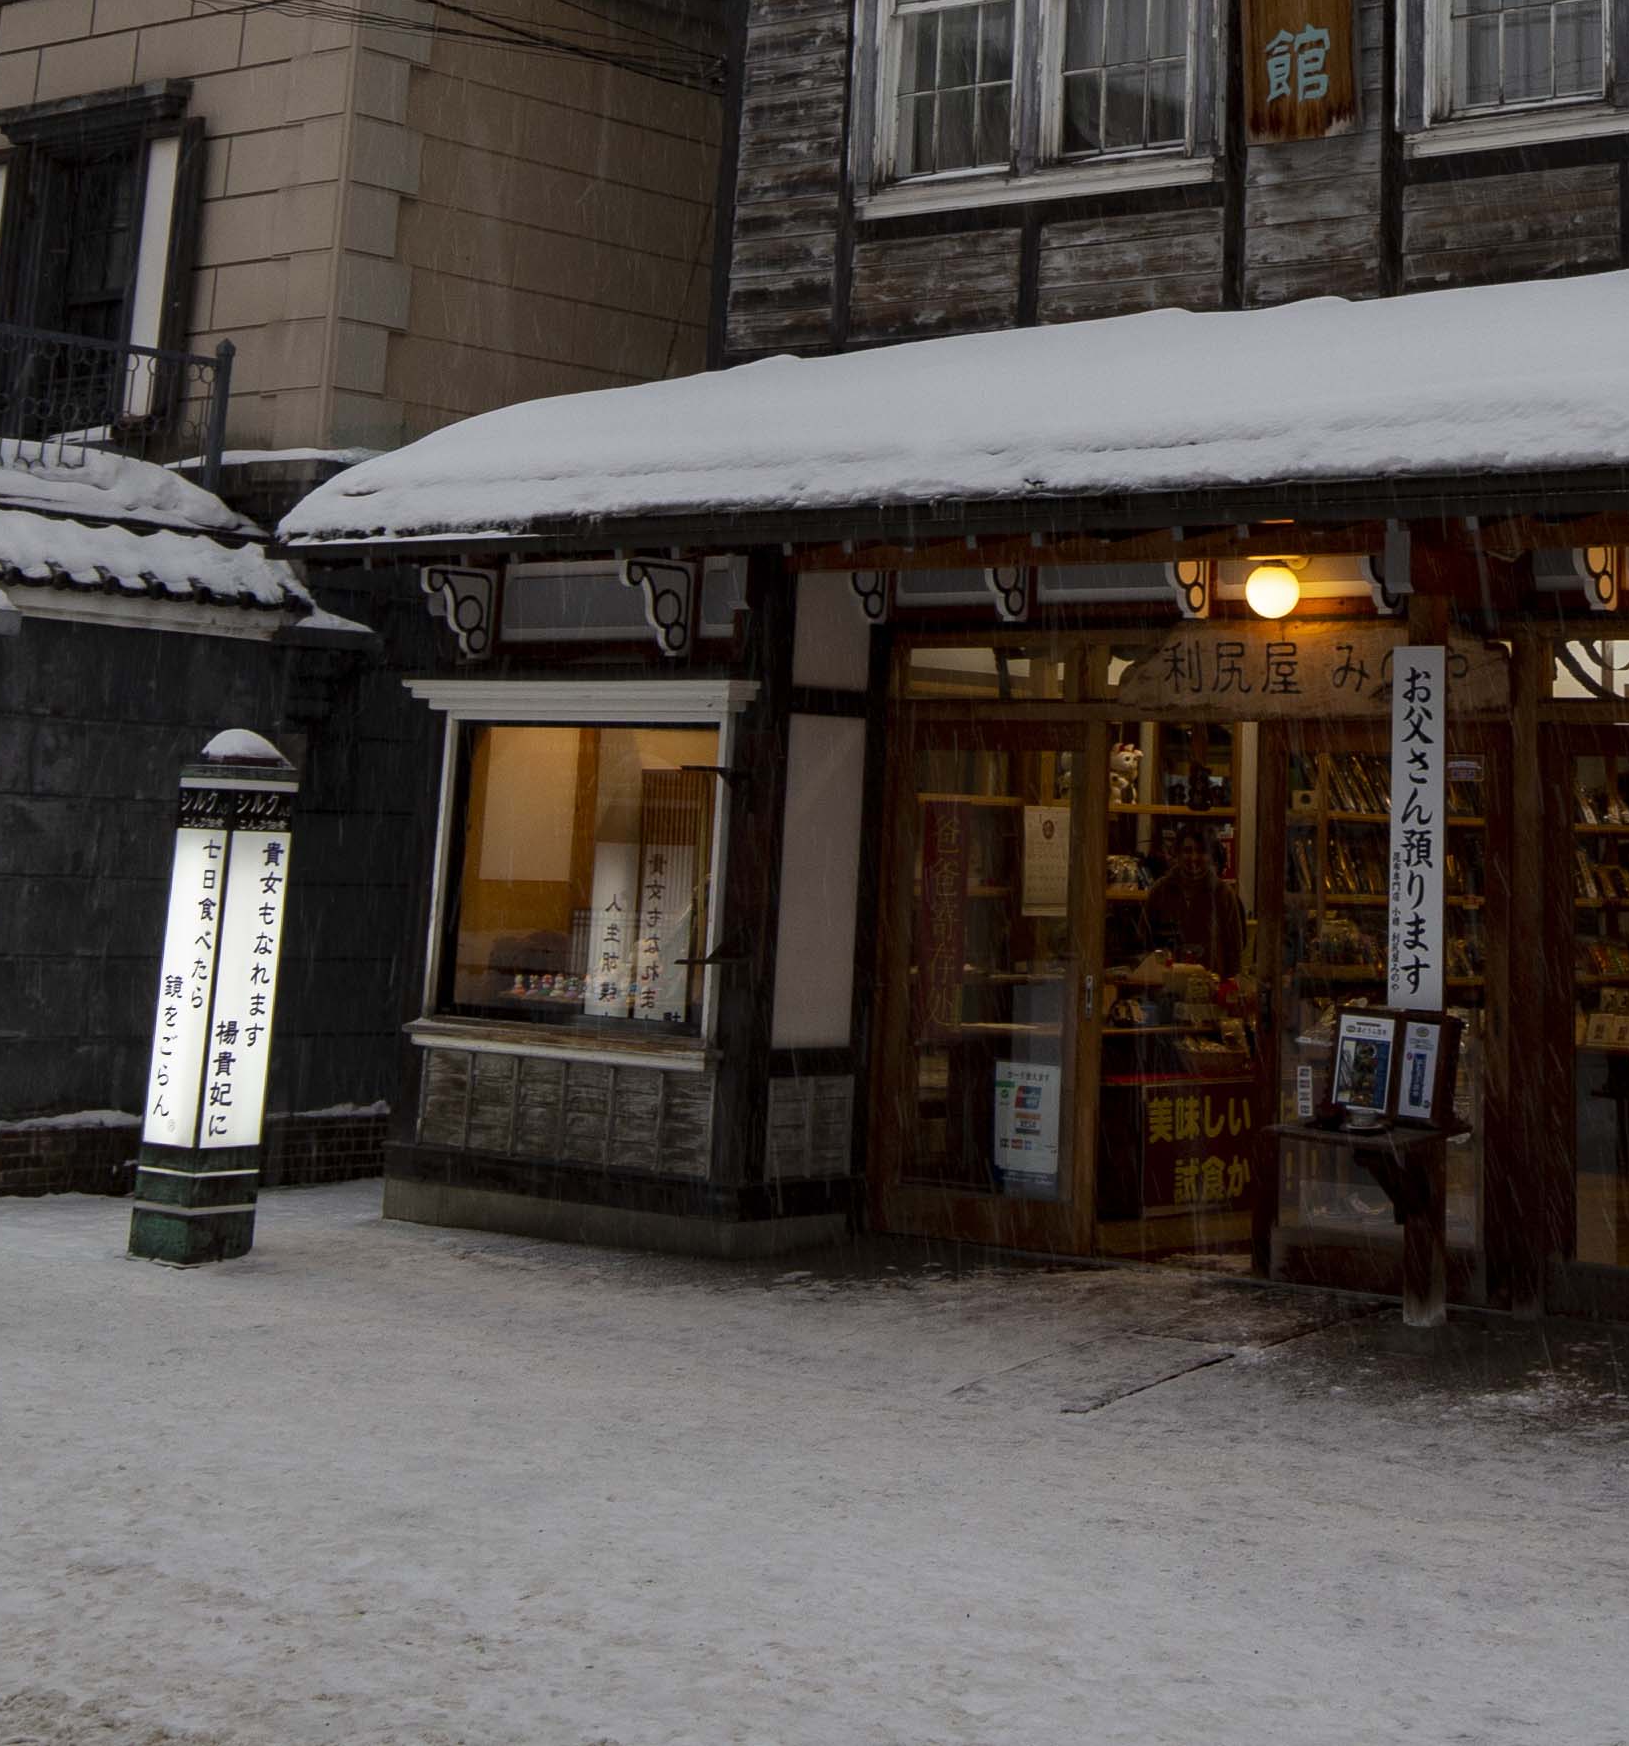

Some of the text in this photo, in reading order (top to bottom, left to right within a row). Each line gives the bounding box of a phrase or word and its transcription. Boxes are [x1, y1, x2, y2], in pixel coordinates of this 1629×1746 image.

[1163, 641, 1303, 695] 利尻屋
[1401, 666, 1434, 996] お父さん預ります
[190, 838, 223, 1009] 七日食べたら
[244, 841, 285, 1047] 貴女もなれます
[152, 974, 184, 1117] 鏡をごらん
[1146, 1094, 1252, 1145] 美味しい
